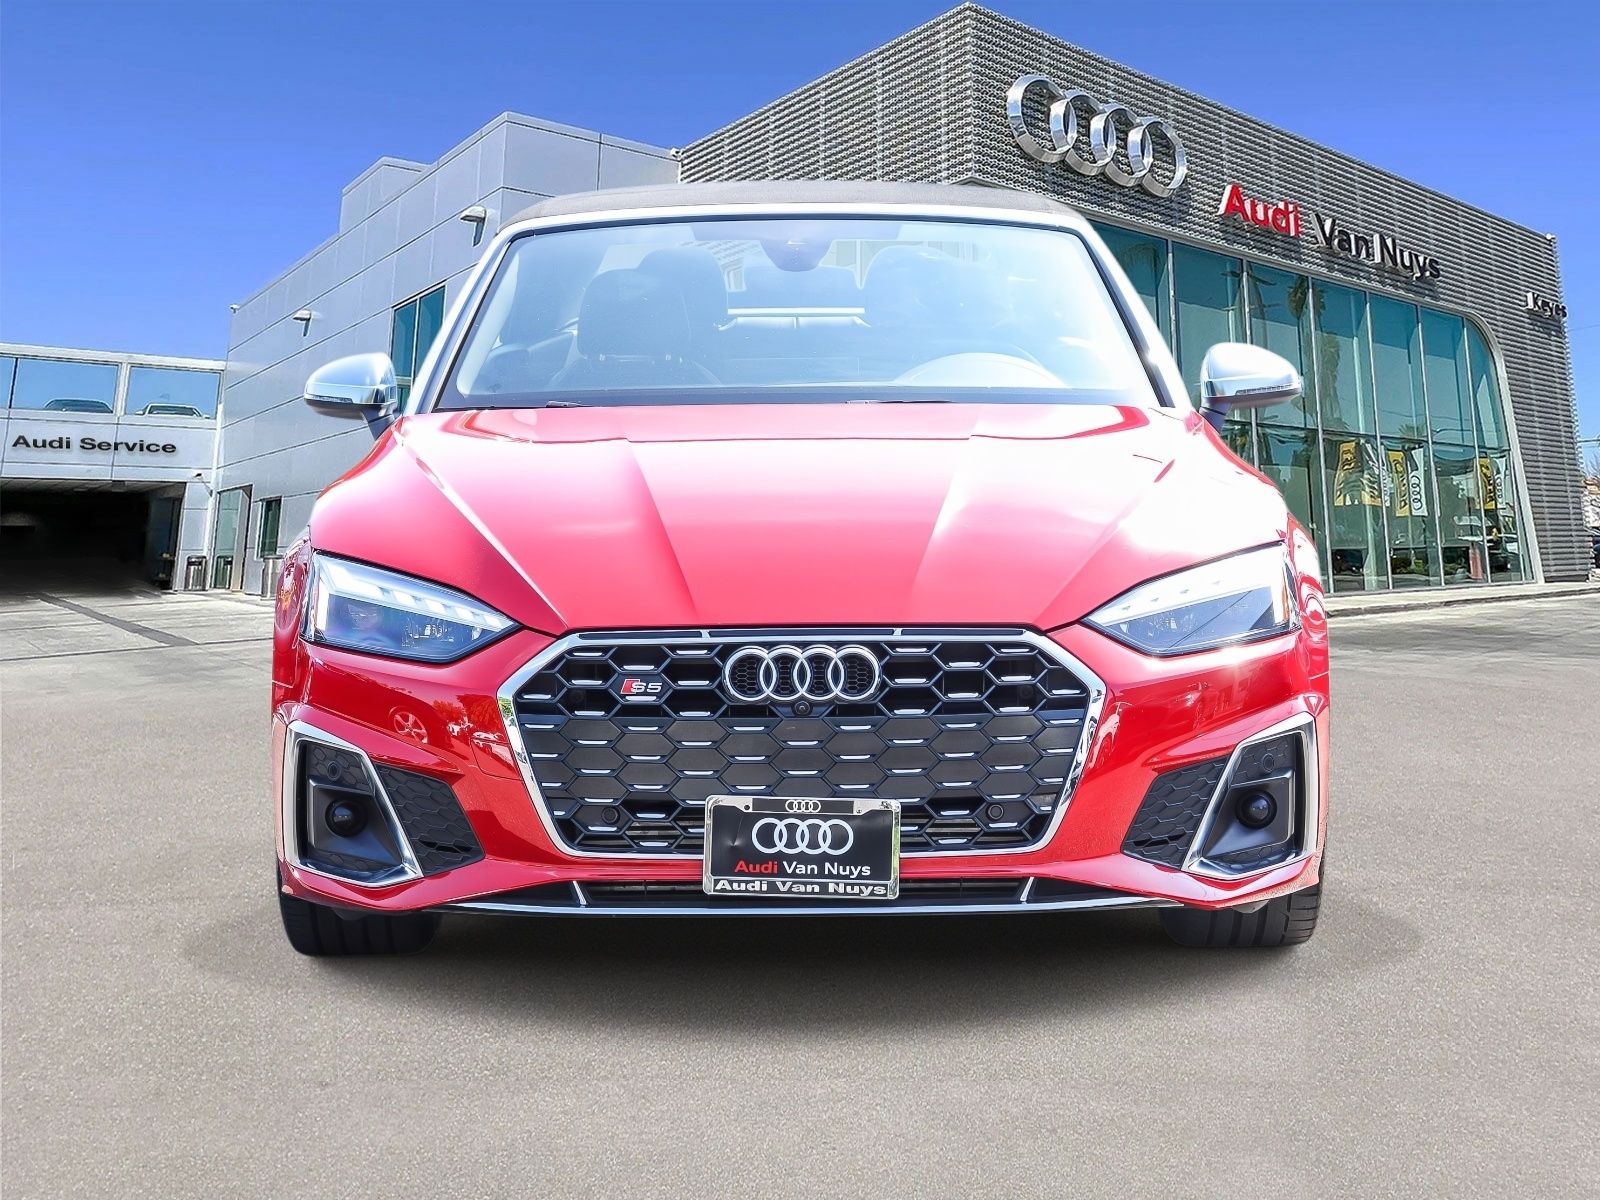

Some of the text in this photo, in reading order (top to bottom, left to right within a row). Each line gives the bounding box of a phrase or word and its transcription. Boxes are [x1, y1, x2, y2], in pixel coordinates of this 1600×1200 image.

[1219, 183, 1441, 280] Audi Van Nuys
[12, 434, 177, 454] Audi Service
[630, 682, 663, 693] S5
[734, 860, 871, 878] Audi Van Nuys
[714, 879, 887, 897] Audi Van Nuys
